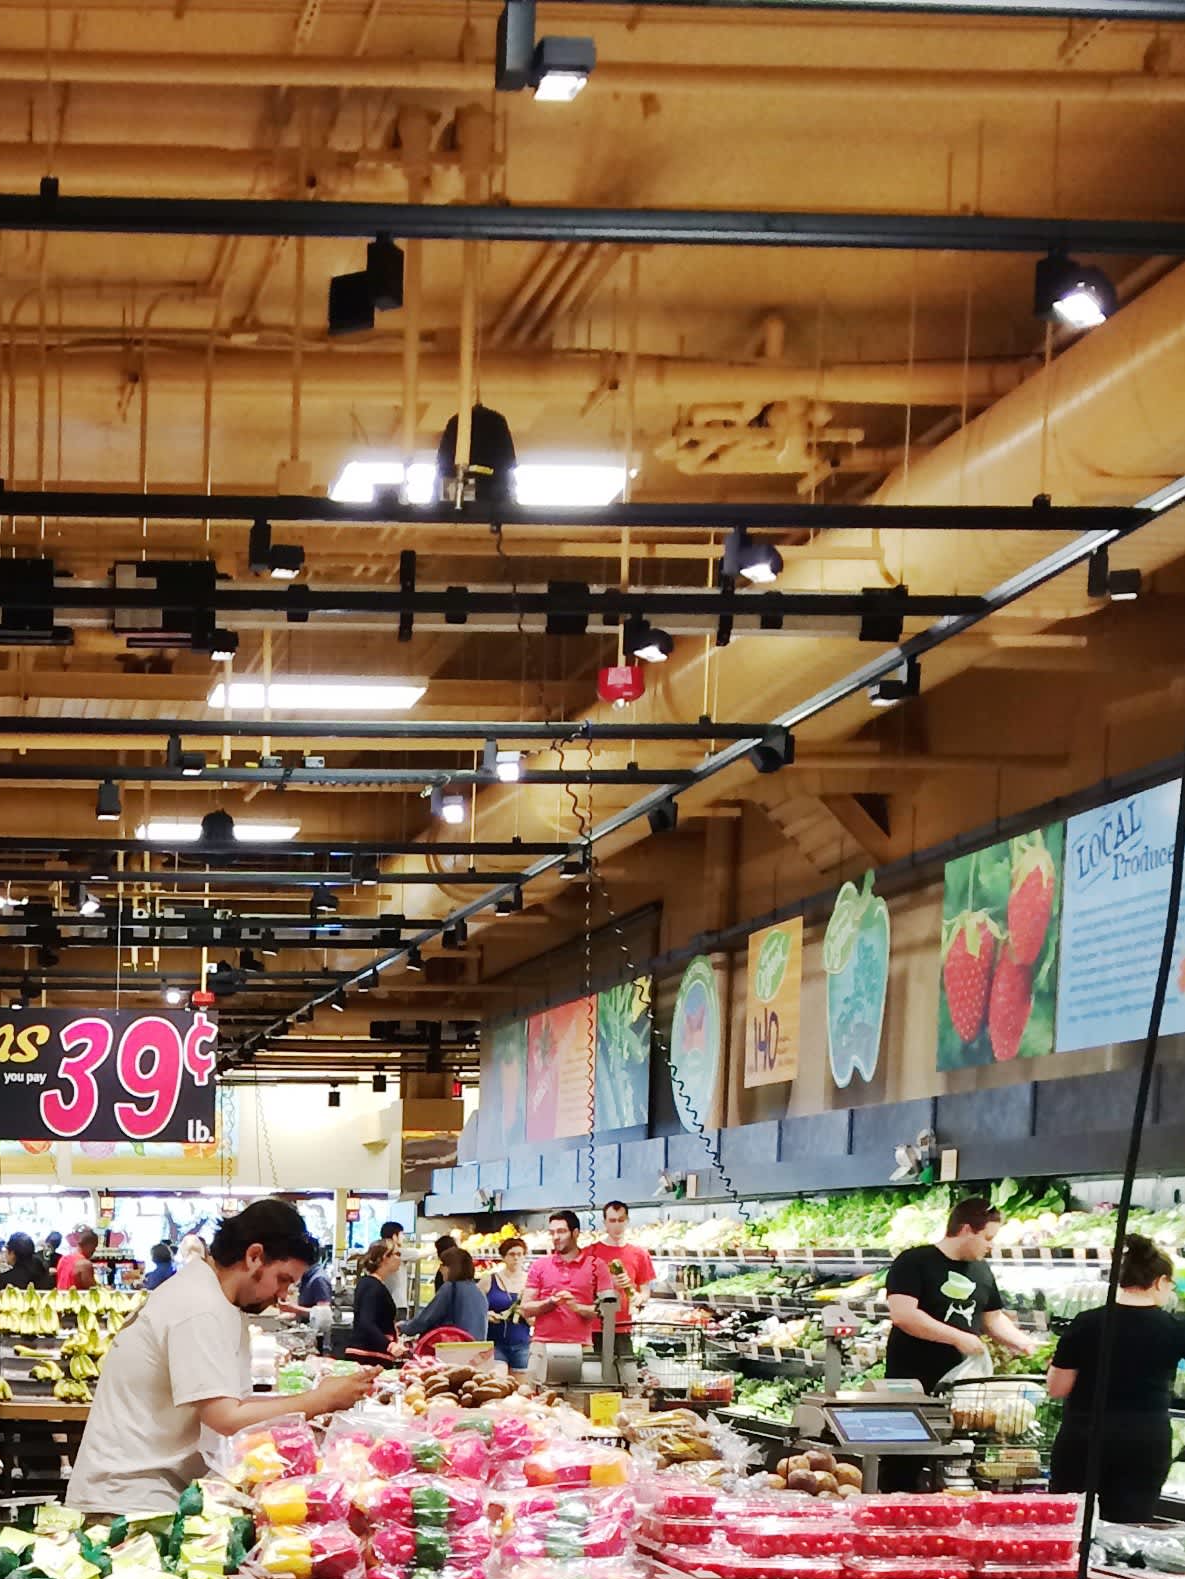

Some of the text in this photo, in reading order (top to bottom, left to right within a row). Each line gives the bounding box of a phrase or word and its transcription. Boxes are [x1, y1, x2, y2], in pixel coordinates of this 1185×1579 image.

[1077, 800, 1142, 880] LOCAL
[3, 1070, 47, 1085] you pay
[186, 1118, 216, 1143] lb.
